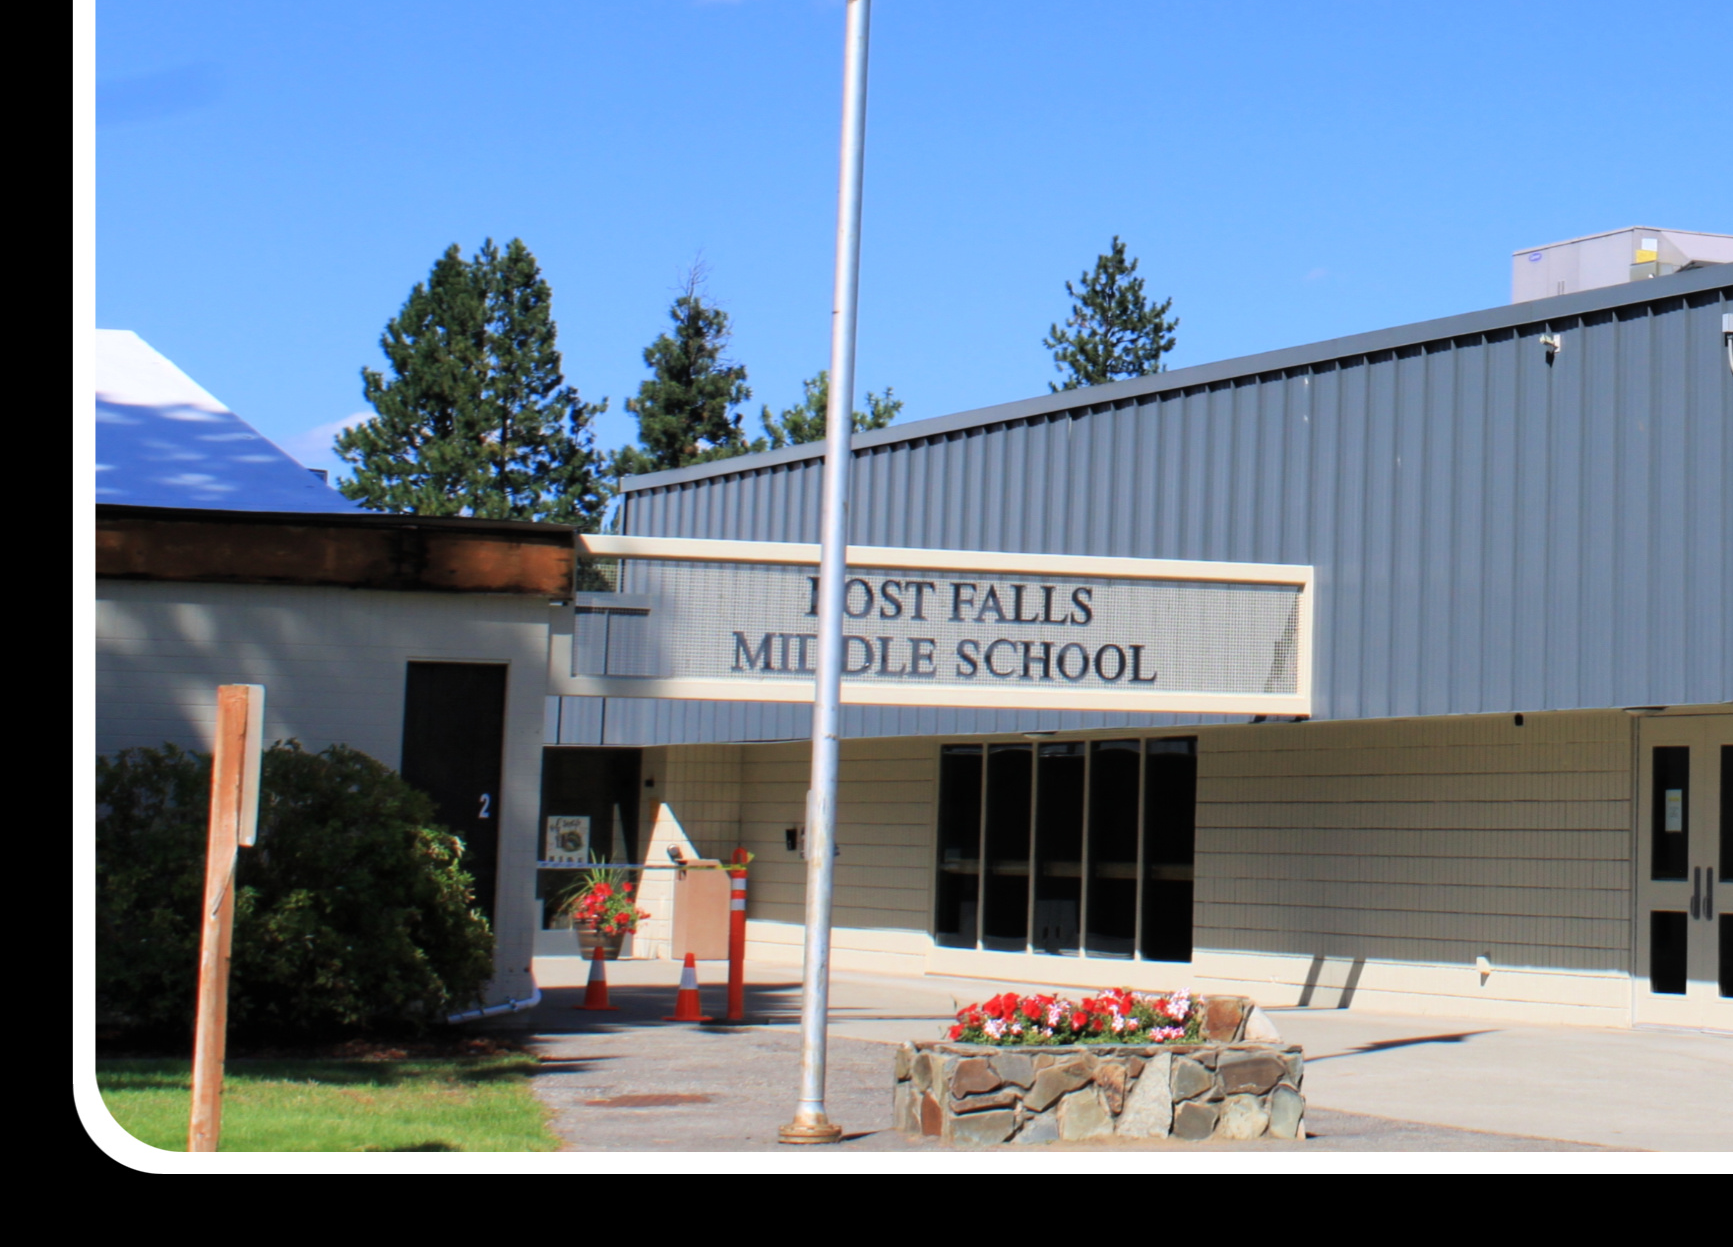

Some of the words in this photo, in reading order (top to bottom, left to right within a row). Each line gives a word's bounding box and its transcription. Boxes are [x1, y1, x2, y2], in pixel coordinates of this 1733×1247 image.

[949, 583, 1093, 626] FALLS
[956, 638, 1157, 684] SCHOOL
[478, 793, 490, 819] 2
